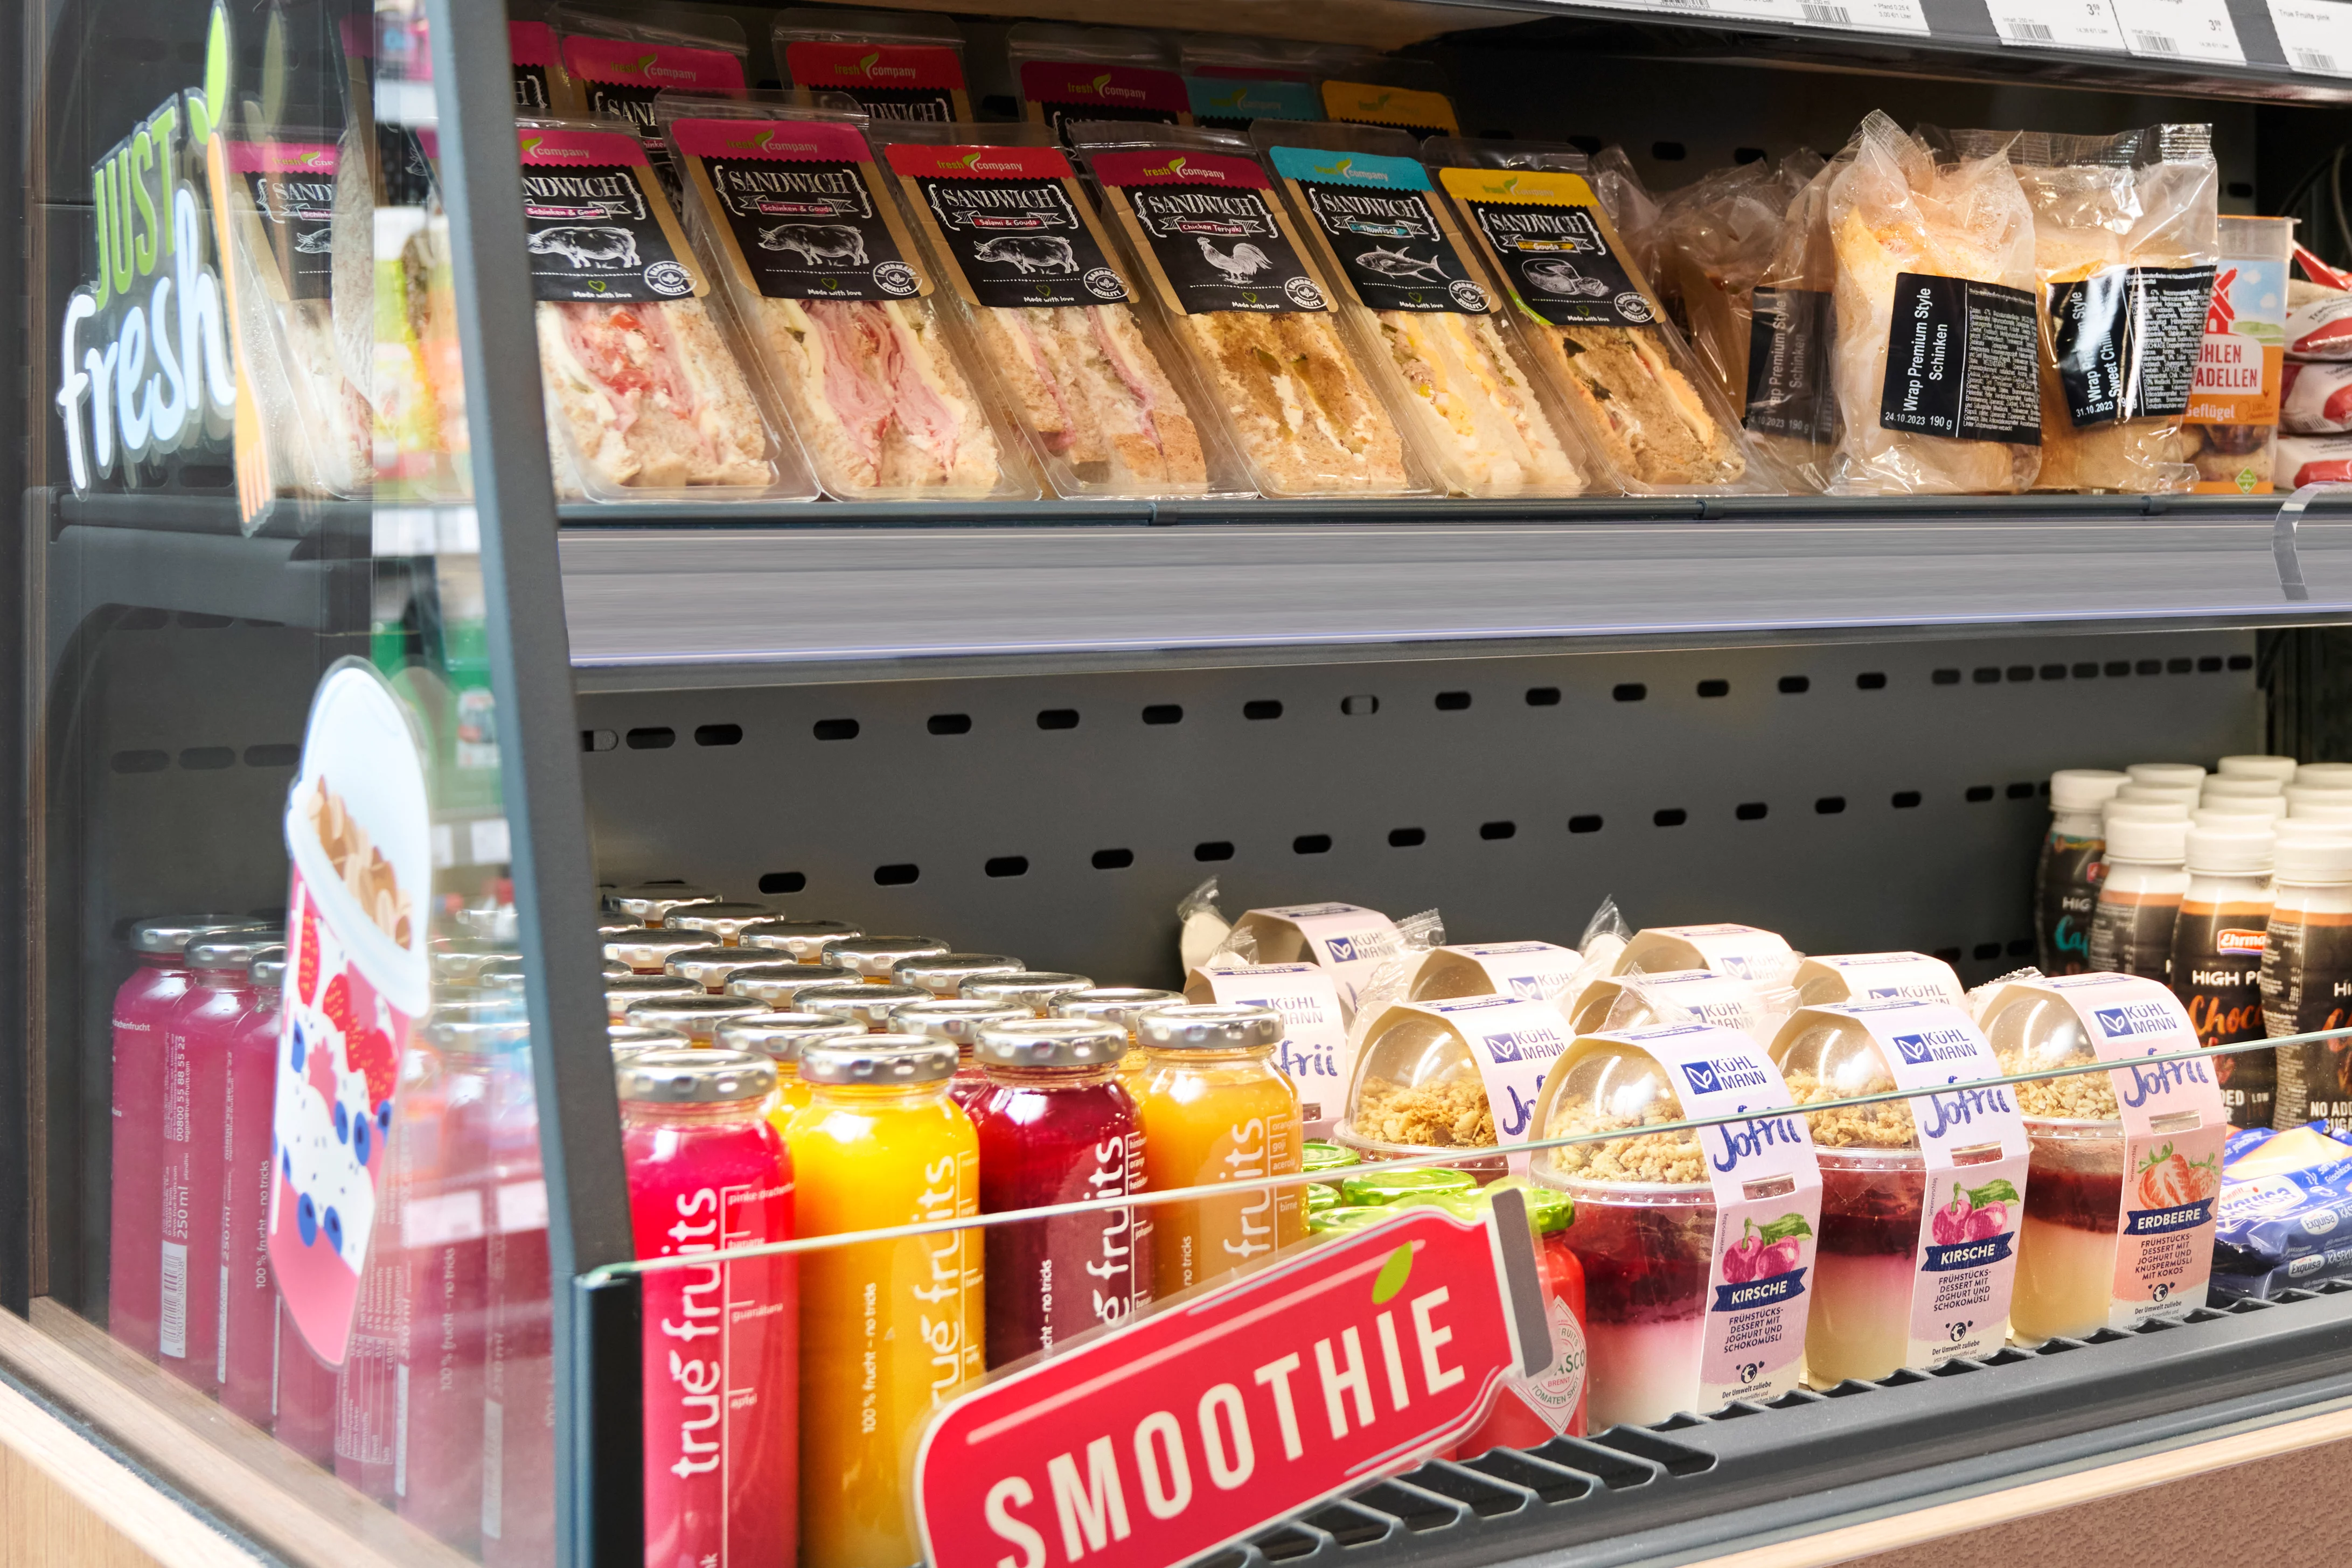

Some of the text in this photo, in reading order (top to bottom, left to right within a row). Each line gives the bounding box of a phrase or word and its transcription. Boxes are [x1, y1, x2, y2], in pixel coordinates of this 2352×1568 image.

[2279, 9, 2294, 17] True
[2295, 11, 2315, 19] Fruits
[651, 66, 697, 81] company
[834, 63, 916, 79] fresh company
[1068, 82, 1146, 100] fresh company
[538, 147, 589, 159] company
[769, 141, 818, 154] company
[937, 159, 1023, 172] fresh company
[1143, 167, 1225, 180] fresh company
[524, 176, 620, 198] NDWICH
[729, 171, 852, 194] SANDWICH
[942, 189, 1057, 209] SANDWICH
[1147, 194, 1258, 216] SANDWICH
[1320, 193, 1421, 219] SANDWICH
[93, 106, 176, 311] JUST
[527, 207, 566, 215] Schinken
[762, 204, 833, 213] Schinken & Gouda
[979, 218, 1004, 227] Salami
[1013, 219, 1037, 227] Gouda
[1182, 222, 1242, 234] Chicken Teriyaki
[1361, 225, 1398, 235] Thunfisch
[1488, 213, 1586, 234] SANDWICH
[1533, 242, 1559, 250] Gouda
[808, 288, 827, 296] Made
[1232, 301, 1250, 309] Made
[1773, 300, 1787, 330] Style
[57, 188, 237, 489] fresh
[2070, 291, 2102, 403] Wrap Style
[1903, 288, 1933, 412] Wrap Premium Style
[1929, 324, 1948, 381] Schinken
[1767, 332, 1787, 387] Premium
[1789, 334, 1805, 389] Schinken
[2104, 361, 2120, 398] Sweet
[2195, 367, 2258, 387] ADELLEN
[2076, 401, 2114, 417] 31.10.2023
[1885, 412, 1926, 426] 24.10.2023
[1930, 416, 1952, 430] 190 g
[2220, 933, 2266, 947] Ehrma
[2191, 970, 2239, 987] HIGH
[2124, 1003, 2170, 1020] KÜHL
[2132, 1016, 2178, 1034] MANN
[1923, 1029, 1970, 1046] KÜHL
[1279, 1040, 1338, 1077] frii
[1521, 1042, 1565, 1060] MANN
[1931, 1043, 1978, 1061] MANN
[1710, 1056, 1759, 1074] KÜHL
[177, 1035, 186, 1141] 00800 55 88 55 22
[1720, 1070, 1767, 1090] MANN
[2310, 1101, 2352, 1117] NO ADD
[1272, 1139, 1286, 1153] goji
[1272, 1158, 1296, 1170] acerola
[2129, 1145, 2138, 1182] Serviervorschlag
[1219, 1117, 1271, 1258] fruits
[1927, 1177, 1938, 1216] Serviervorschlag
[728, 1191, 757, 1205] pinke
[1279, 1201, 1298, 1212] birne
[177, 1186, 189, 1239] 250 ml
[1083, 1135, 1130, 1280] fruits
[256, 1160, 270, 1288] 100 % frucht no tricks
[2138, 1208, 2201, 1230] ERDBEERE
[2304, 1214, 2335, 1230] Exquisa
[1718, 1213, 1729, 1254] Serviervorschlag
[2141, 1233, 2193, 1248] FRÜHSTÜCKS-
[1940, 1243, 1996, 1265] KIRSCHE
[2138, 1249, 2191, 1265] JOGHURT UND
[2142, 1241, 2190, 1256] DESSERT MIT
[1183, 1235, 1193, 1287] no tricks
[2135, 1257, 2193, 1274] KNUSPERMÜSLI
[2291, 1260, 2321, 1274] Exquisa
[913, 1154, 961, 1410] rue fruits
[1939, 1269, 1992, 1285] FRÜHSTÜCKS-
[2142, 1266, 2183, 1280] MIT KOKOS
[1039, 1259, 1052, 1313] no tricks
[1731, 1280, 1788, 1305] KIRSCHE
[1935, 1286, 1991, 1303] JOGHURT UND
[1940, 1278, 1988, 1293] DESSERT MIT
[732, 1301, 784, 1323] guanábana
[1933, 1294, 1989, 1312] SCHOKOMÜSLI
[2144, 1304, 2163, 1313] Umwelt
[2164, 1300, 2182, 1309] zuliebe
[1729, 1306, 1784, 1326] FRÜHSTÜCKS-
[1730, 1315, 1780, 1334] DESSERT MIT
[661, 1187, 722, 1479] true fruits
[1561, 1327, 1579, 1348] RUITS
[1725, 1324, 1783, 1344] JOGHURT UND
[1724, 1333, 1782, 1353] SCHOKOMÜSLI
[1942, 1343, 1961, 1353] Umwelt
[1962, 1340, 1980, 1349] zuliebe
[862, 1282, 877, 1434] 100 % frucht no tricks
[1554, 1348, 1585, 1376] ASCO
[1532, 1376, 1579, 1404] TOMATEN SHOT
[1548, 1376, 1571, 1388] BRENNT
[1722, 1381, 1772, 1399] Der Umwelt zuliebe
[730, 1393, 758, 1409] apfel
[984, 1285, 1464, 1568] SMOOTHIE
